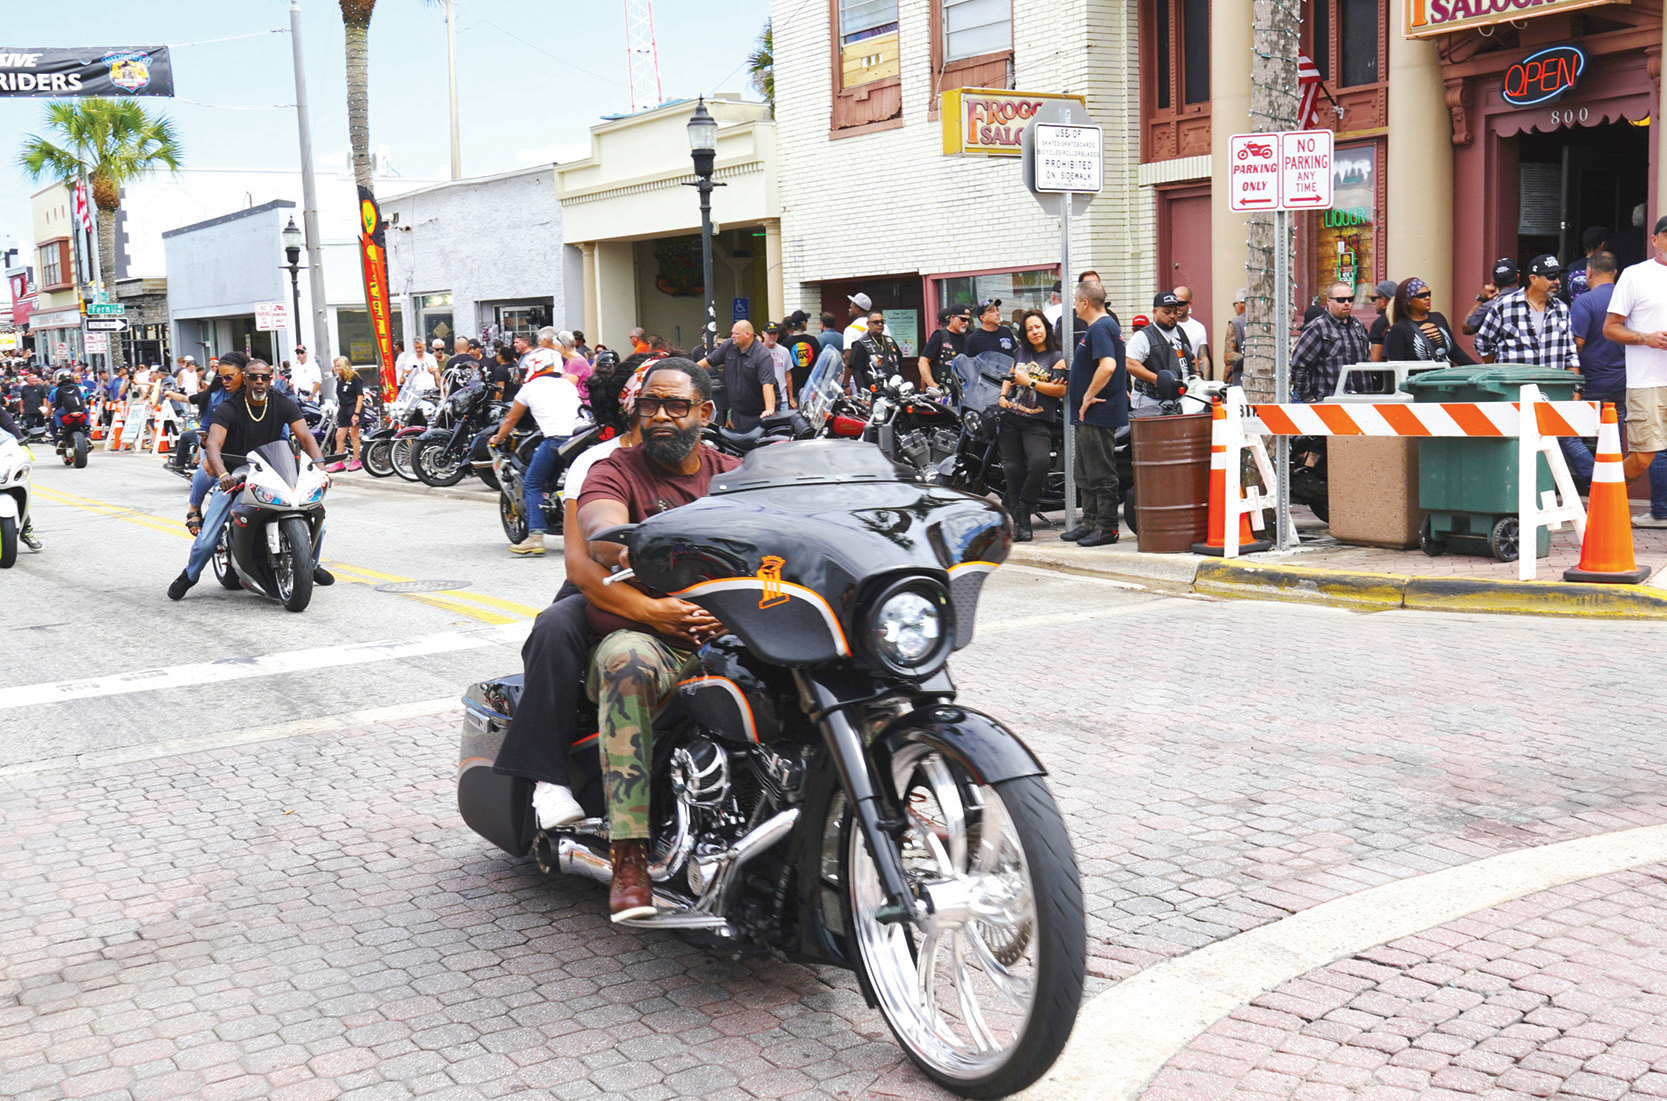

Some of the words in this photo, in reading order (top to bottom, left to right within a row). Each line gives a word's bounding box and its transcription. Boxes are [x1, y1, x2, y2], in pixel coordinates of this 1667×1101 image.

[1504, 54, 1578, 96] OPEN
[0, 73, 83, 91] RIDERS
[1551, 107, 1588, 125] 800
[1055, 129, 1070, 138] USE
[1073, 130, 1081, 138] OF
[1297, 138, 1315, 152] NO
[1045, 159, 1092, 170] PROHIBITED
[1285, 154, 1328, 170] PARKING
[1233, 163, 1277, 174] PARKING
[1046, 171, 1055, 179] ON
[1061, 172, 1091, 180] SIDEWALK
[1297, 171, 1315, 181] ANY
[1242, 181, 1268, 191] ONLY
[1296, 182, 1317, 192] TIME
[1324, 207, 1366, 227] LIQUOR
[92, 305, 111, 313] Fern
